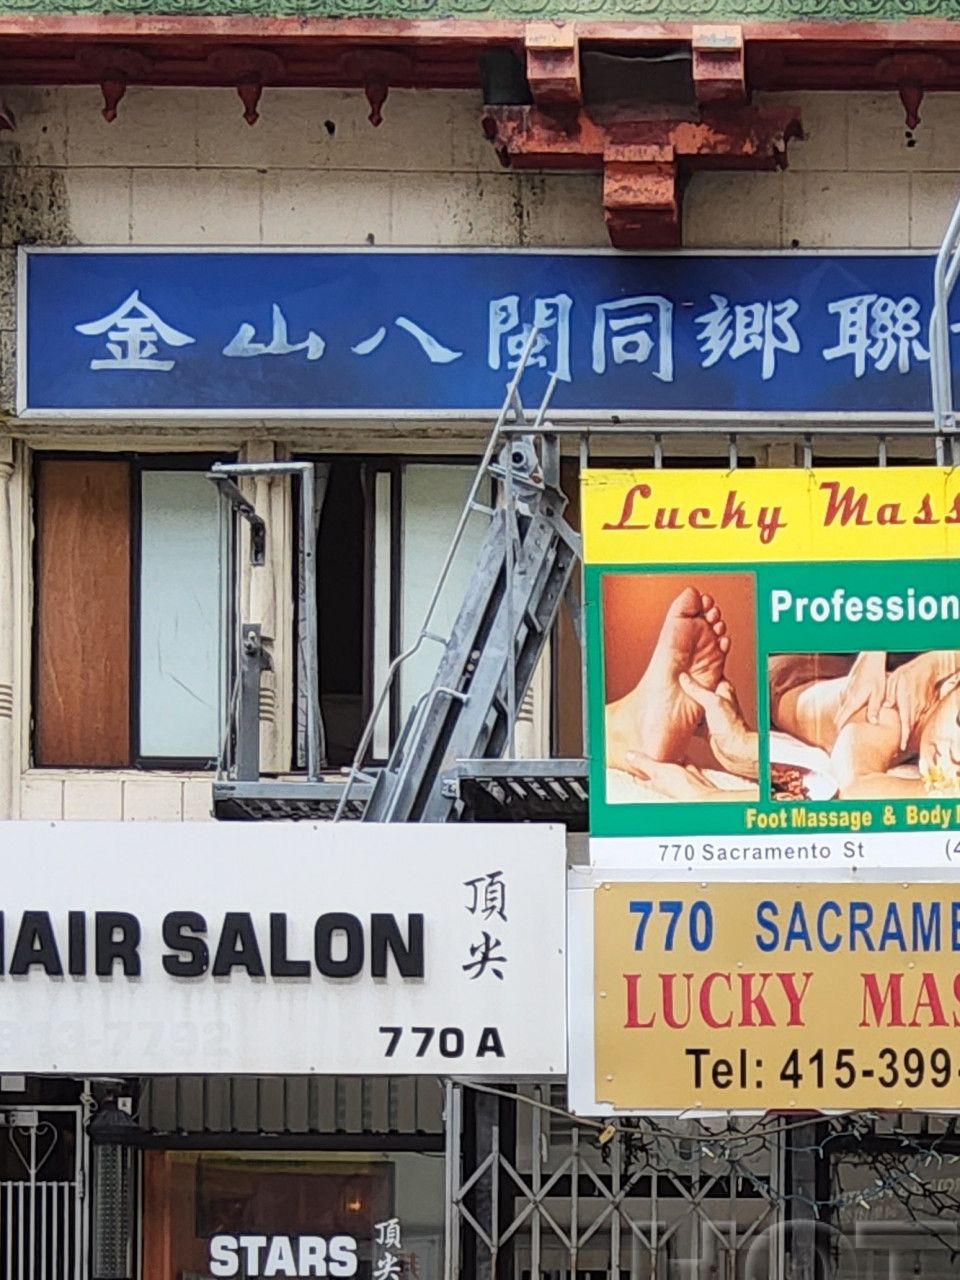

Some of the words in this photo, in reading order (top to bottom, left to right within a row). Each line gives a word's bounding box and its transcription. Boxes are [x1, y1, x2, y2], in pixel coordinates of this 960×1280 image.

[602, 484, 787, 544] Lucky
[746, 809, 788, 828] Foot
[791, 808, 873, 830] Massage
[883, 808, 897, 825] &
[906, 806, 952, 827] Body
[659, 844, 696, 862] 770
[702, 842, 831, 862] Sacramento
[843, 841, 866, 859] St
[0, 910, 141, 978] AIR
[162, 910, 426, 980] SALON
[461, 870, 508, 981] 頂尖
[629, 900, 714, 952] 770
[623, 971, 813, 1029] LUCKY
[685, 1048, 765, 1090] Tel:
[209, 1235, 358, 1279] STARS
